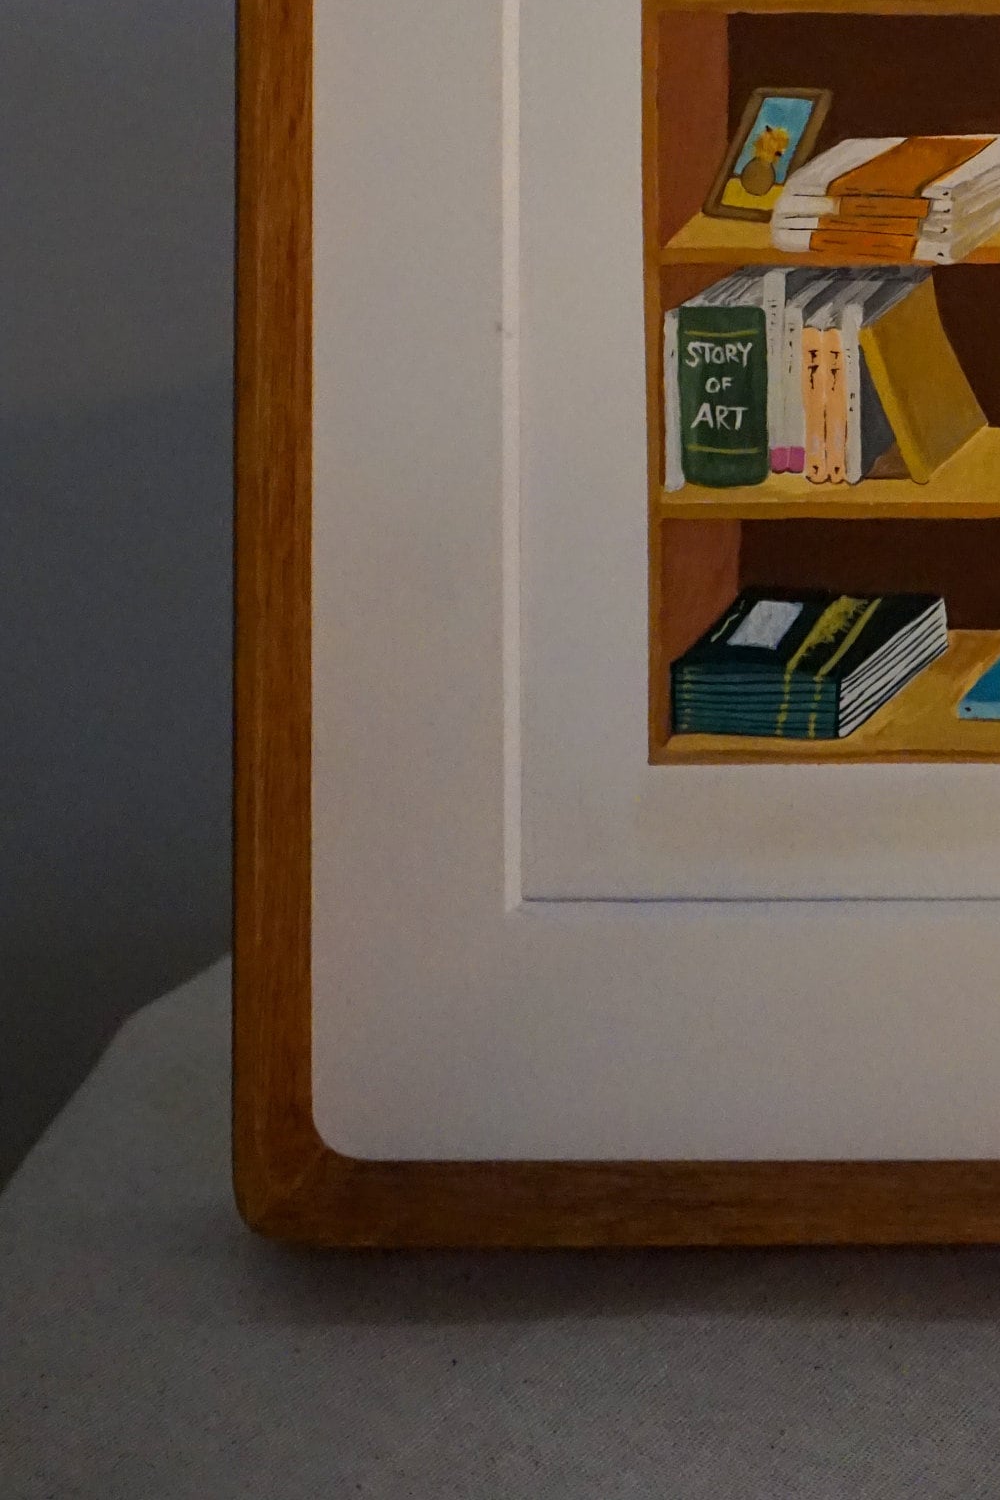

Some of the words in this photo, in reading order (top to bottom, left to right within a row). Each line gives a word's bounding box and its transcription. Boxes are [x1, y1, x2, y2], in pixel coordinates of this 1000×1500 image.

[684, 341, 753, 368] STORY
[705, 376, 734, 394] OF
[690, 402, 749, 431] ART
